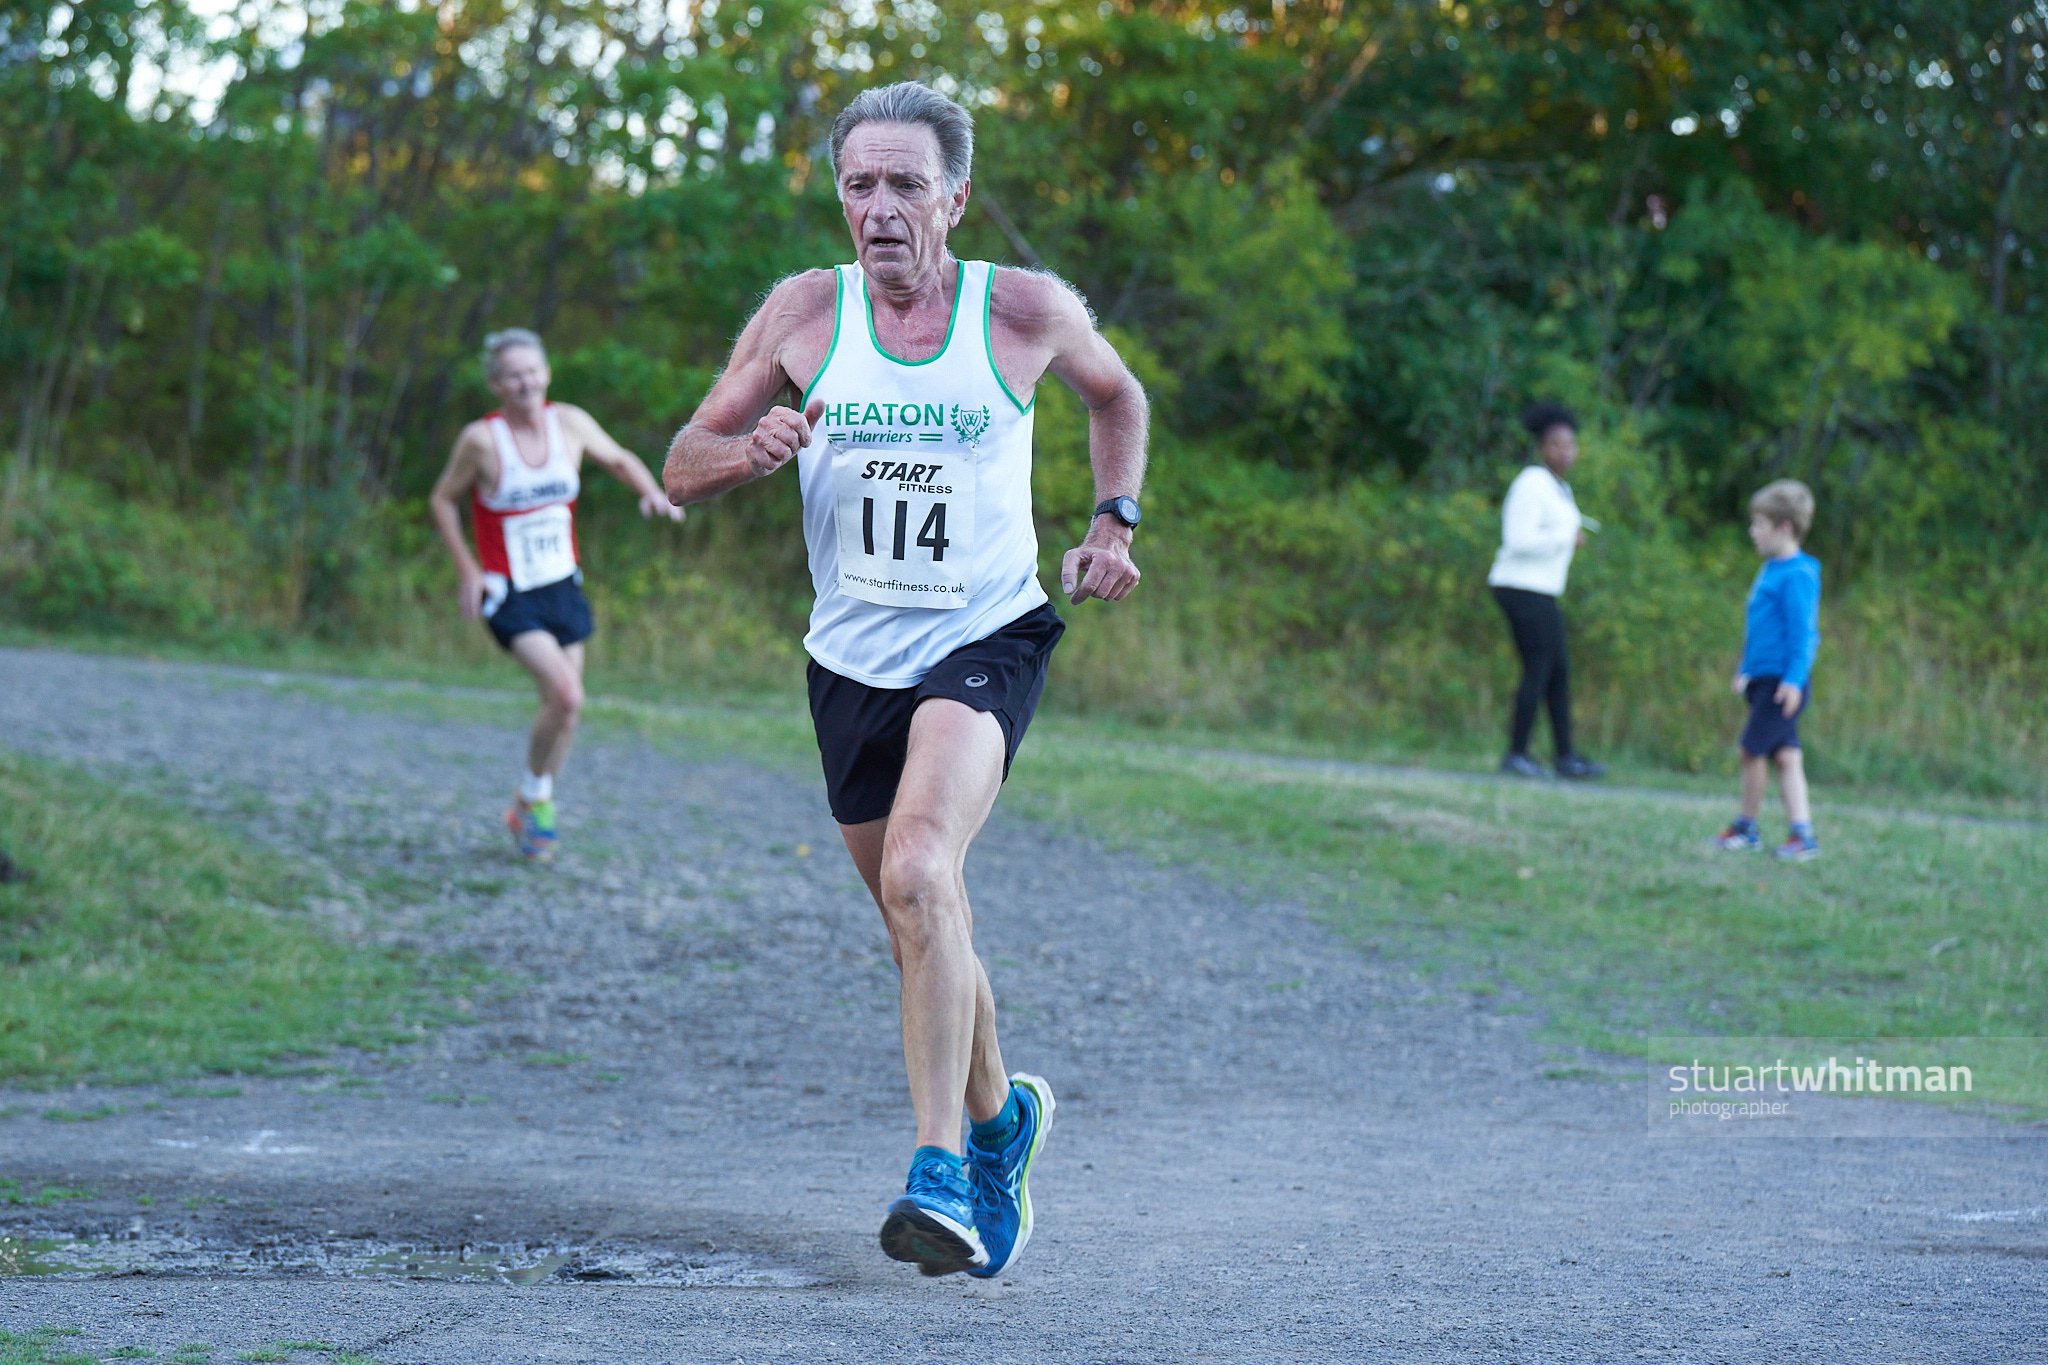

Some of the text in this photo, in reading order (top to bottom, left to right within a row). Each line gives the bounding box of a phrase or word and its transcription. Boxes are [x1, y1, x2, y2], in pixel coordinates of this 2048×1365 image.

[825, 402, 944, 427] HEATON
[852, 430, 913, 443] Harriers
[861, 460, 943, 483] START
[899, 483, 953, 494] FITNESS
[862, 497, 949, 562] 114
[844, 572, 965, 593] www.startfitness.co.uk
